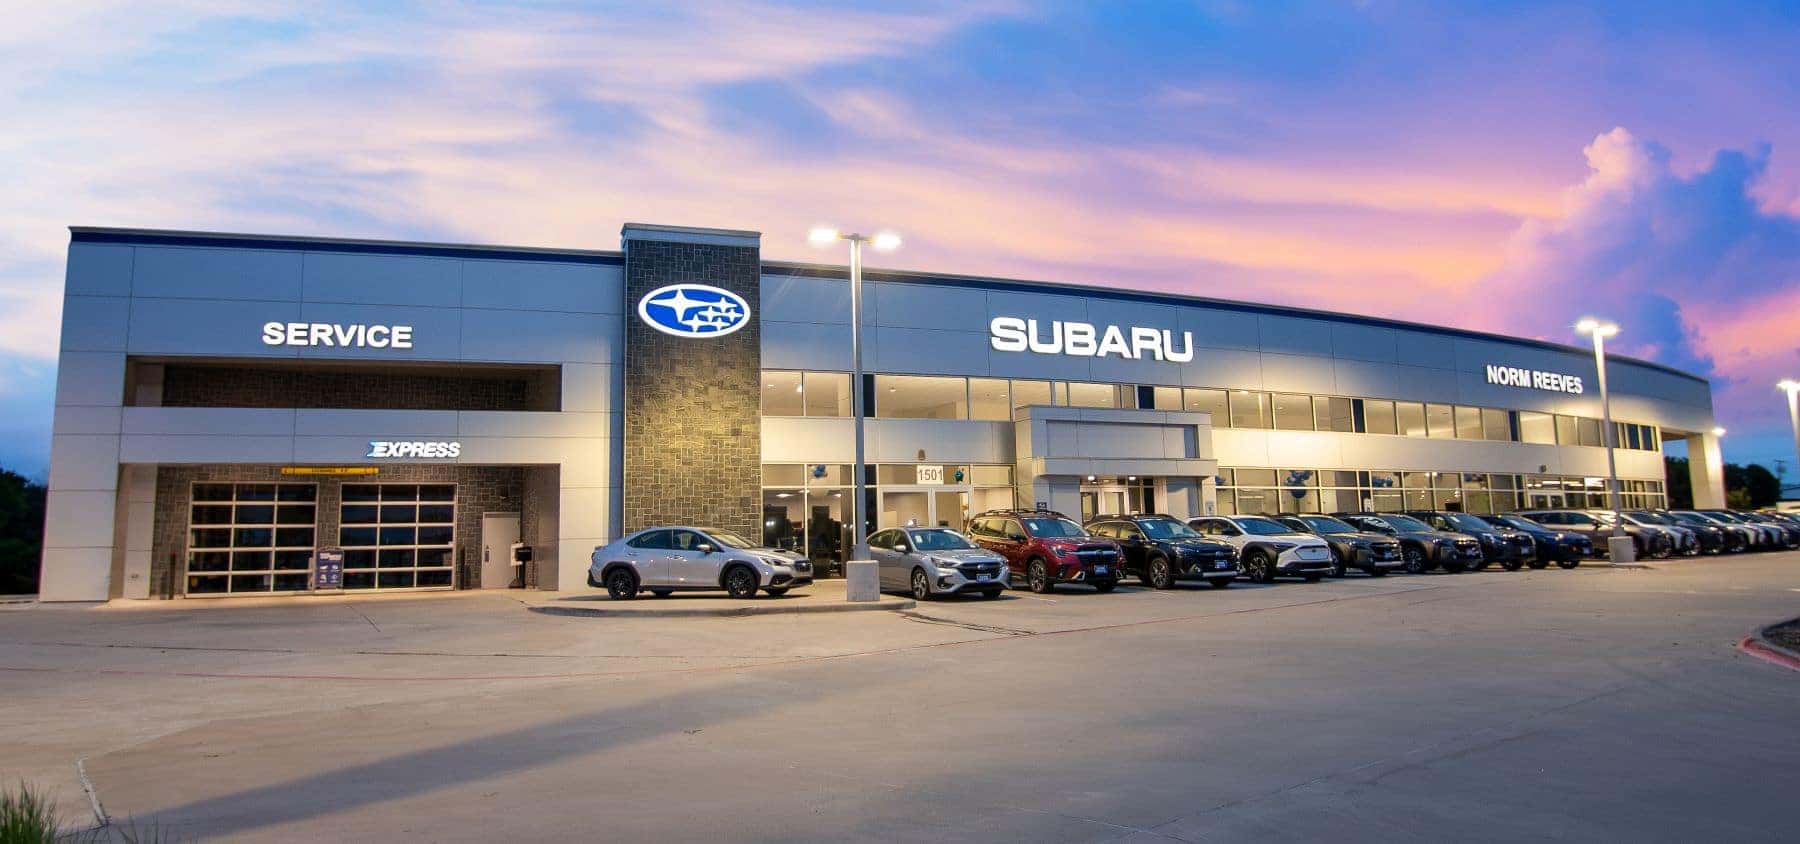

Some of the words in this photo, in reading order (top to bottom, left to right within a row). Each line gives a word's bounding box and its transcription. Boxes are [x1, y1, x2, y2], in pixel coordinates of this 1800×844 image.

[262, 322, 413, 348] SERVICE
[990, 317, 1194, 363] SUBARU
[1486, 364, 1531, 388] NORM
[1532, 370, 1584, 394] REEVES
[366, 441, 461, 458] EXPRESS
[919, 469, 943, 481] 1501
